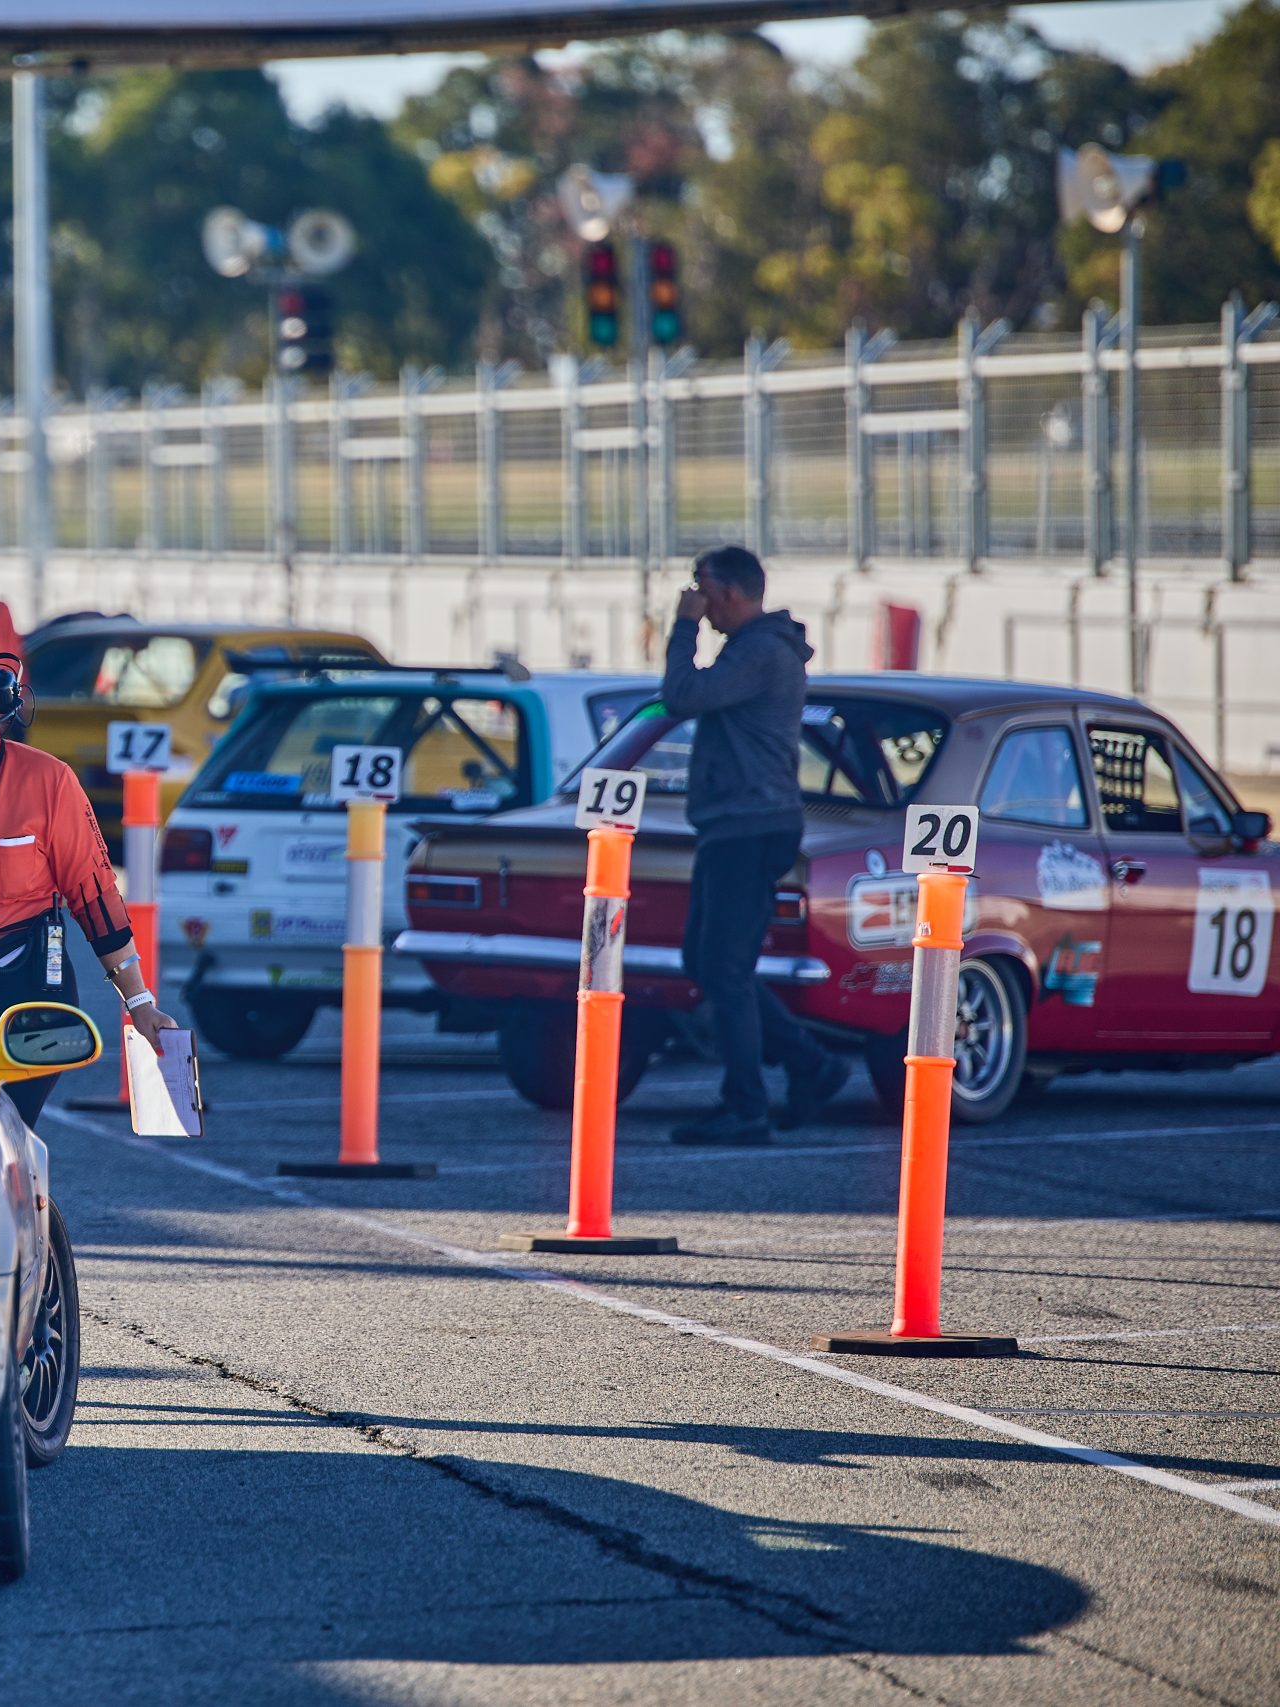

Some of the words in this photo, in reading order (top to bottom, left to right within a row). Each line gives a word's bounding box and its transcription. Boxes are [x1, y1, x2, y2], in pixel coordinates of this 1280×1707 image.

[115, 729, 165, 760] 17
[339, 753, 394, 789] 18
[585, 777, 638, 816] 19
[910, 813, 972, 857] 20
[1209, 907, 1256, 980] 18
